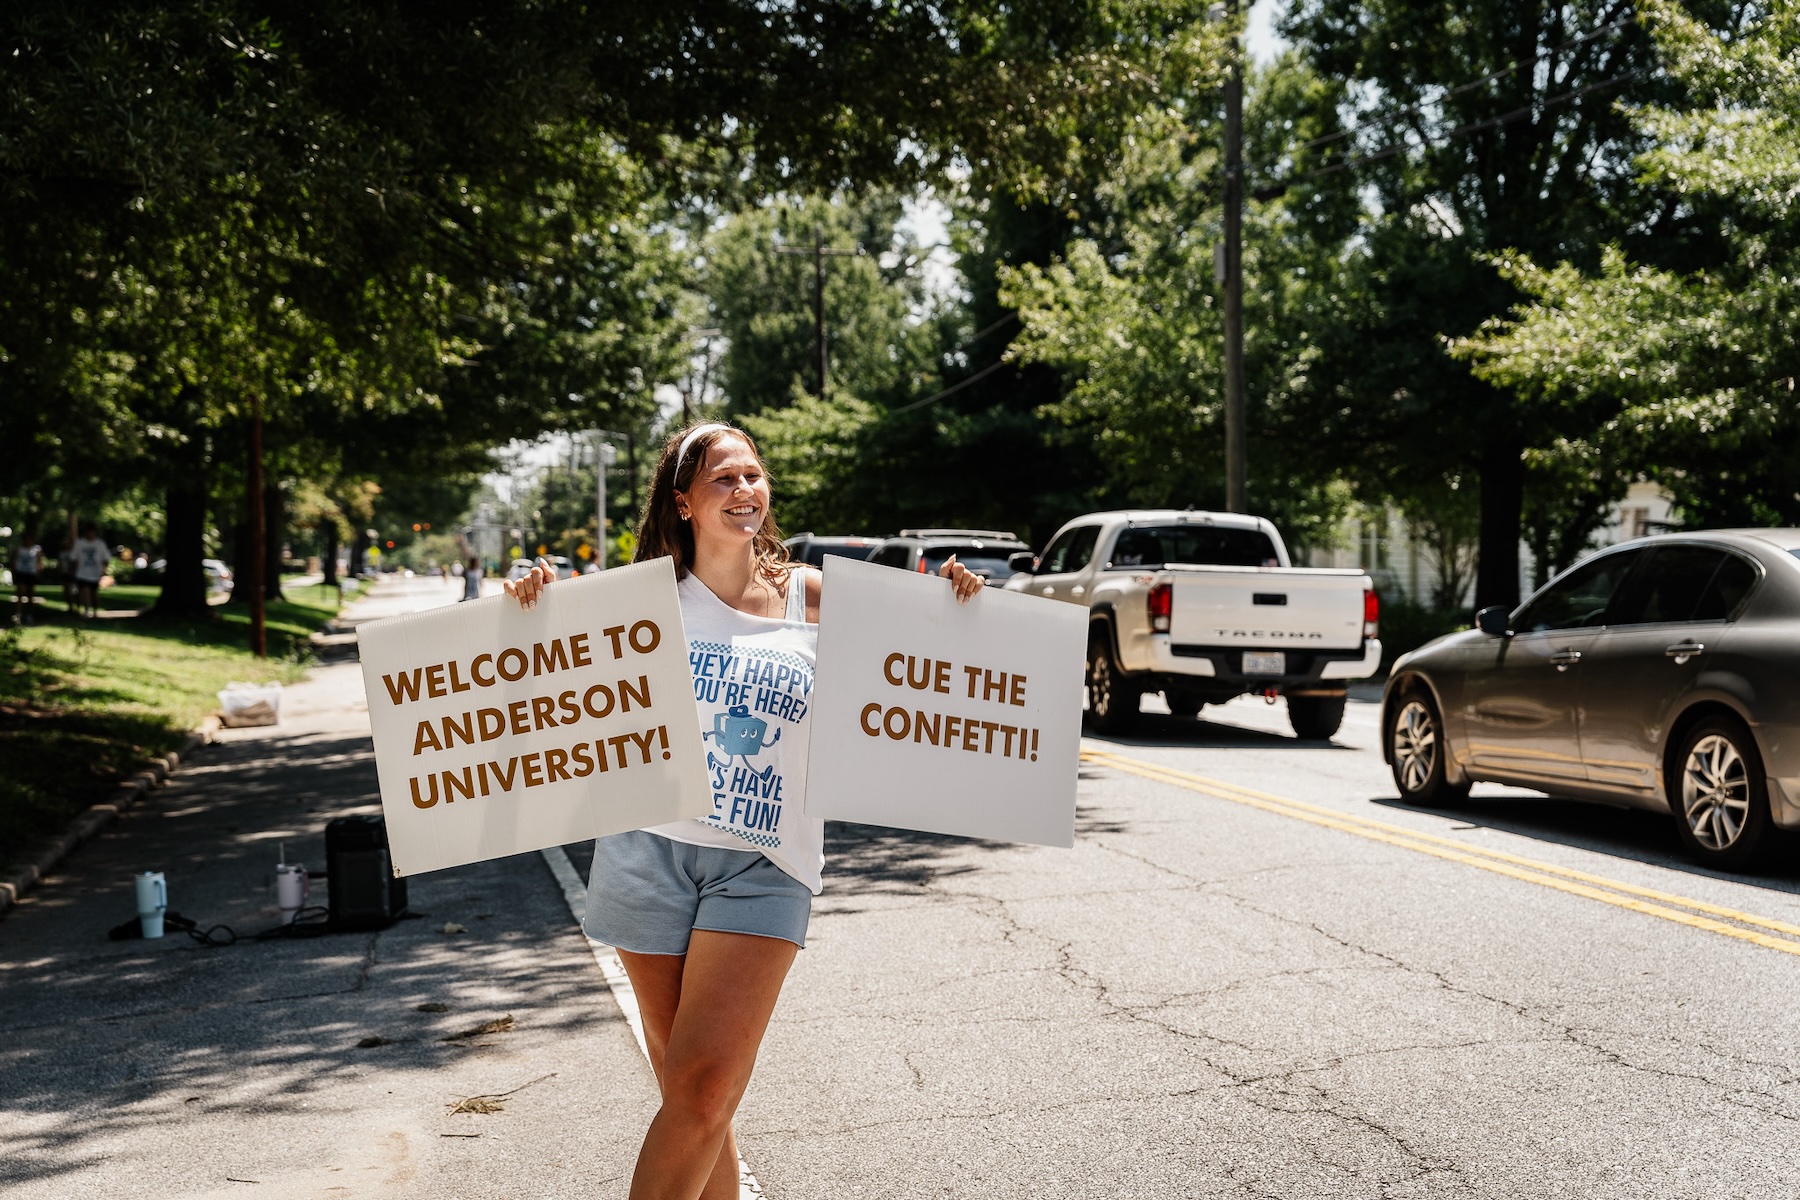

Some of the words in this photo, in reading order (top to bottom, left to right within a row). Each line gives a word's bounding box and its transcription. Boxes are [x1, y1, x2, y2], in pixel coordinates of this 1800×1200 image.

[1213, 628, 1323, 639] TACOMA
[383, 633, 593, 705] WELCOME
[603, 619, 661, 660] TO
[689, 652, 740, 681] HEY!
[743, 658, 814, 700] HAPPY
[883, 652, 951, 694] CUE
[964, 665, 1027, 707] THE
[413, 675, 652, 756] ANDERSON
[693, 677, 752, 706] OU'RE
[754, 687, 808, 724] HERE!
[860, 702, 1040, 762] CONFETTI!
[409, 724, 672, 810] UNIVERSITY!
[729, 766, 783, 802] HAVE
[729, 796, 782, 833] FUN!
